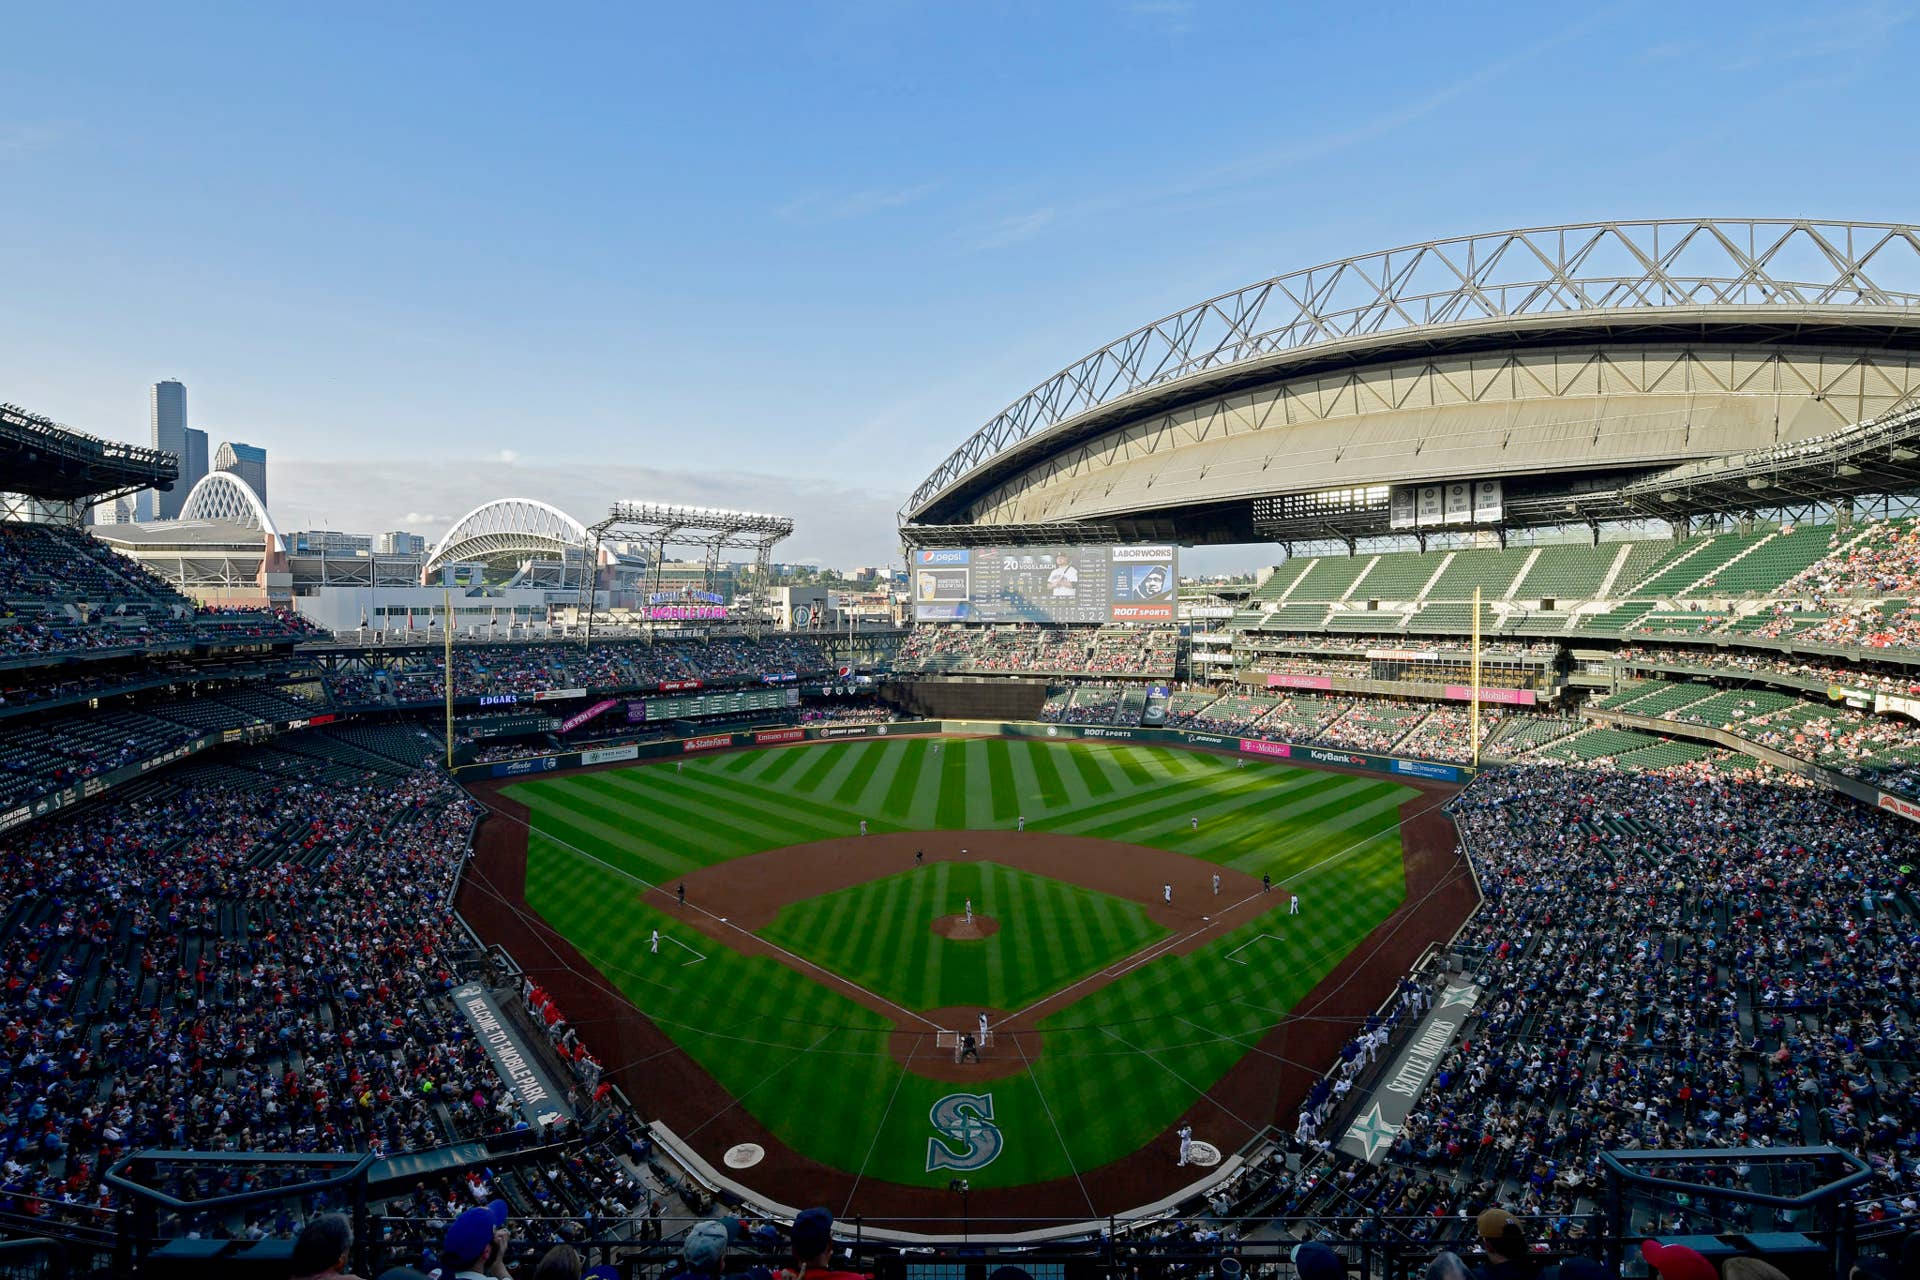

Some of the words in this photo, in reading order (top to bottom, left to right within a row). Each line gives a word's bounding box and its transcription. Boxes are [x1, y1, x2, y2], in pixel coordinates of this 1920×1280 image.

[936, 552, 960, 562] pepsi
[1113, 549, 1171, 558] LABORWORKS
[1003, 561, 1018, 570] 20
[640, 607, 696, 619] T-MOBILE
[698, 607, 728, 618] PARK
[1079, 612, 1086, 621] 3
[1088, 612, 1096, 621] 2
[1098, 612, 1105, 621] 2
[1113, 608, 1139, 616] ROOT
[480, 695, 517, 706] EDGARS
[288, 720, 302, 729] 710
[758, 732, 782, 742] Emirates
[1196, 736, 1222, 744] BOEING
[1311, 750, 1350, 763] KeyBank
[506, 761, 532, 771] Alaska
[465, 997, 501, 1033] WELCOME
[487, 1030, 506, 1044] TO
[1409, 1017, 1456, 1061] MARINERS
[494, 1041, 532, 1080] T-MOBILE
[1386, 1056, 1433, 1098] SEATTLE
[516, 1076, 548, 1105] PARK
[925, 1092, 1004, 1173] S
